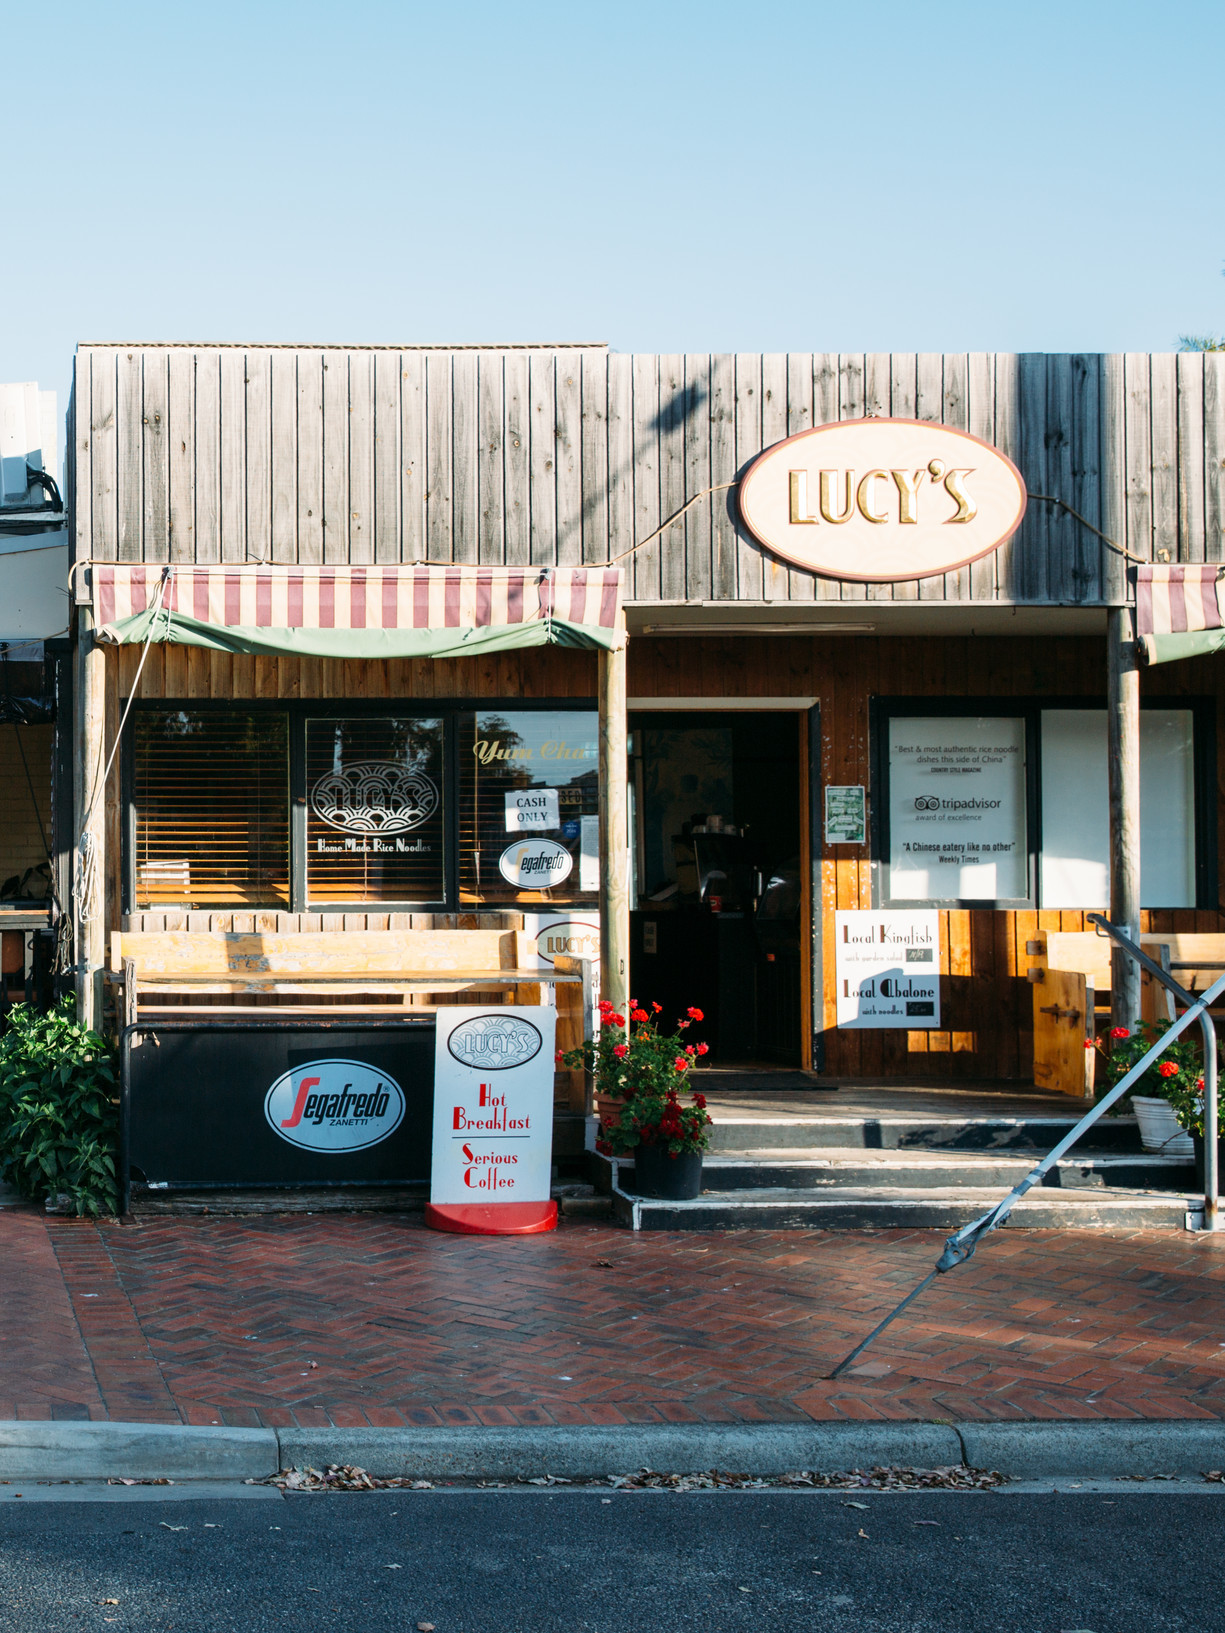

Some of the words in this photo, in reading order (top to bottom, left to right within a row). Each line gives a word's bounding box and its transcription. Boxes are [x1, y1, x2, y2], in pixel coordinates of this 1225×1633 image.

[788, 458, 978, 525] LUCY'S
[472, 740, 535, 765] Yum
[540, 740, 585, 760] Cha
[916, 745, 922, 753] &
[923, 745, 942, 753] most
[943, 745, 977, 753] authentic
[978, 745, 992, 753] rice
[994, 745, 1019, 753] noodle
[916, 755, 939, 763] dishes
[941, 755, 954, 763] this
[955, 755, 970, 763] side
[971, 755, 980, 763] of
[335, 783, 421, 812] LUCY'S
[516, 797, 547, 808] CASH
[942, 797, 1001, 811] tripadvisor
[517, 812, 548, 823] ONLY
[317, 838, 343, 852] Home
[344, 838, 371, 852] Made
[373, 838, 394, 852] Rice
[396, 838, 432, 852] Noodles
[912, 842, 941, 852] Chinese
[942, 843, 965, 853] eatery
[967, 842, 980, 852] like
[981, 844, 991, 852] no
[938, 856, 960, 865] Weekly
[547, 934, 600, 954] LUCY'S
[843, 925, 875, 944] Local
[880, 924, 933, 945] Kingfish
[844, 952, 860, 961] with
[843, 979, 877, 998] Local
[880, 978, 935, 998] Abalone
[862, 1005, 877, 1015] with
[878, 1005, 904, 1015] noodles
[464, 1031, 529, 1054] LUCY'S
[280, 1077, 390, 1128] Segafredo
[478, 1083, 508, 1107] Hot
[329, 1118, 368, 1126] ZANETTI
[452, 1106, 532, 1132] Breakfast
[462, 1142, 518, 1165] Serious
[464, 1166, 515, 1190] Coffee
